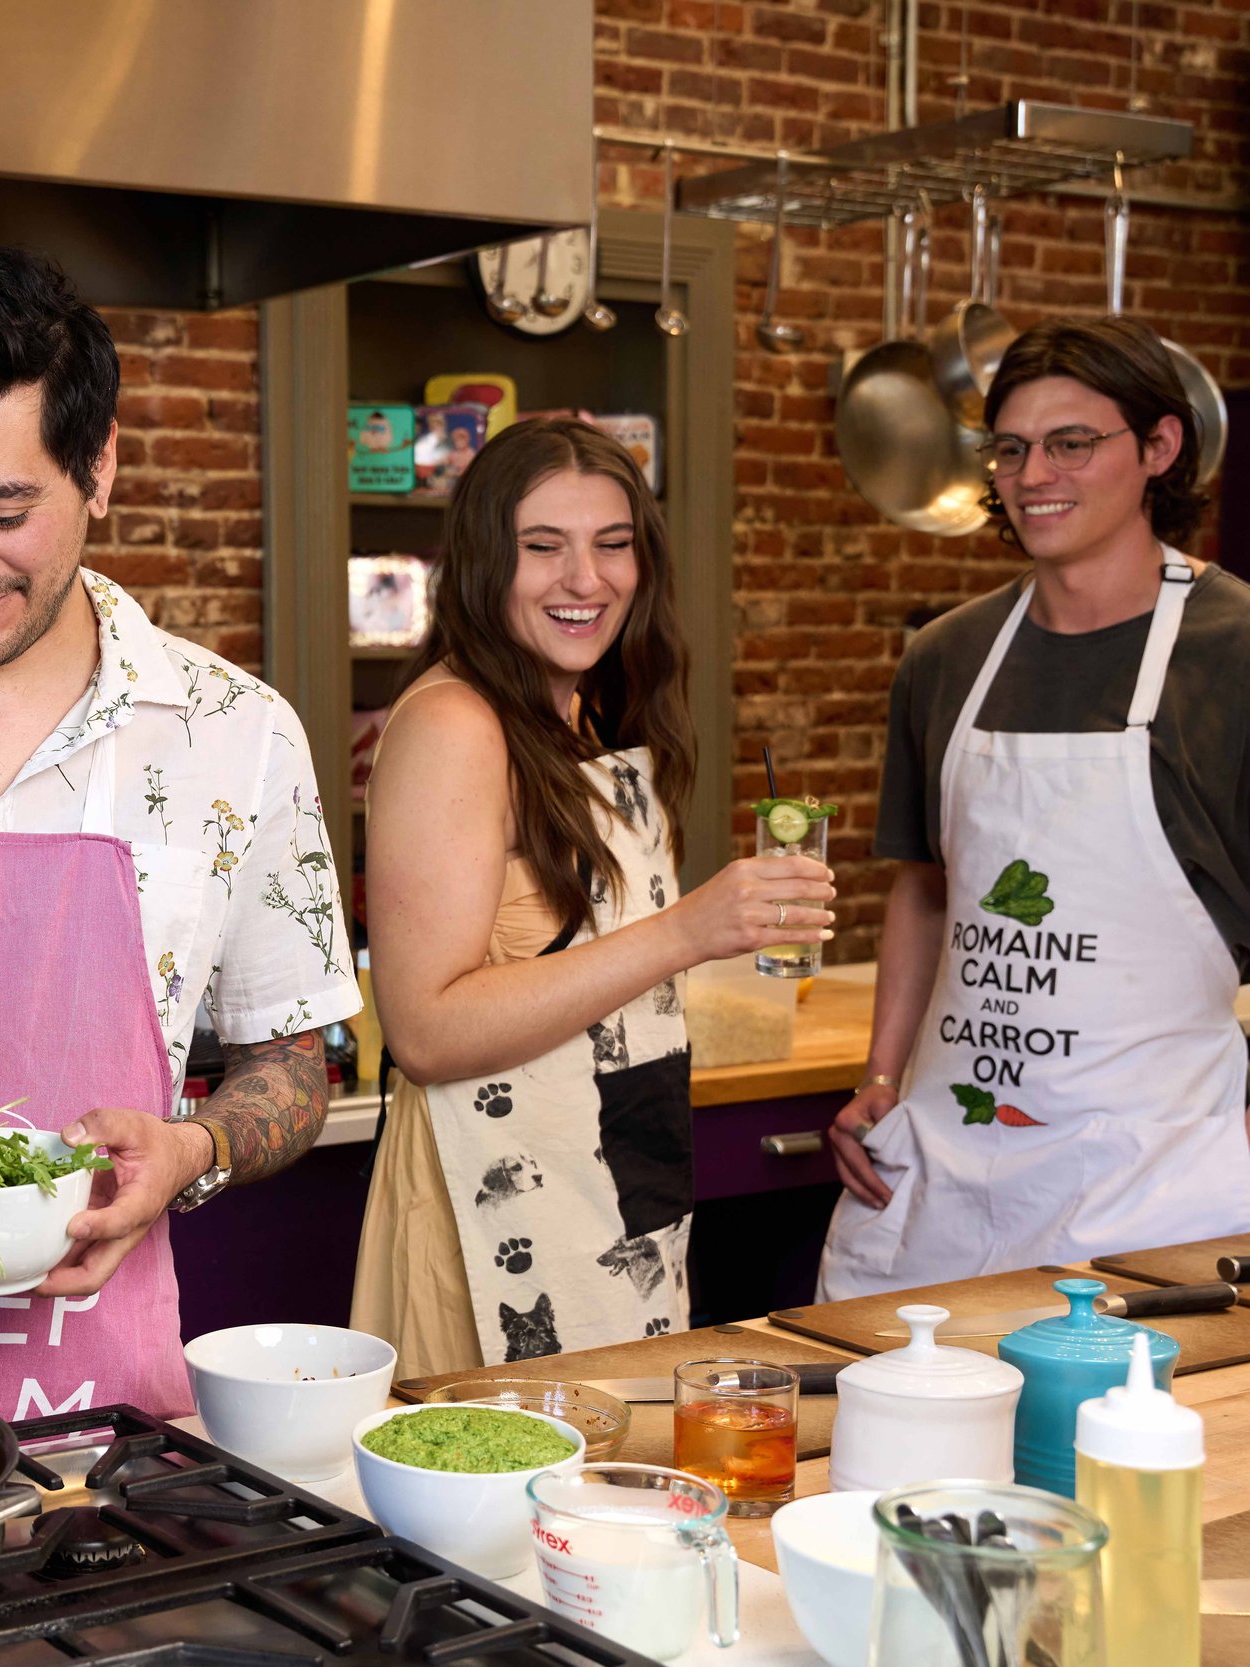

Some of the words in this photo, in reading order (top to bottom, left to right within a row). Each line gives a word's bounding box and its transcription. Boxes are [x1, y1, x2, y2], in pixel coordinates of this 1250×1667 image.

[950, 922, 1098, 963] ROMAINE
[960, 958, 1058, 996] CALM
[980, 998, 1020, 1015] AND
[939, 1014, 1080, 1057] CARROT
[972, 1055, 1025, 1087] ON
